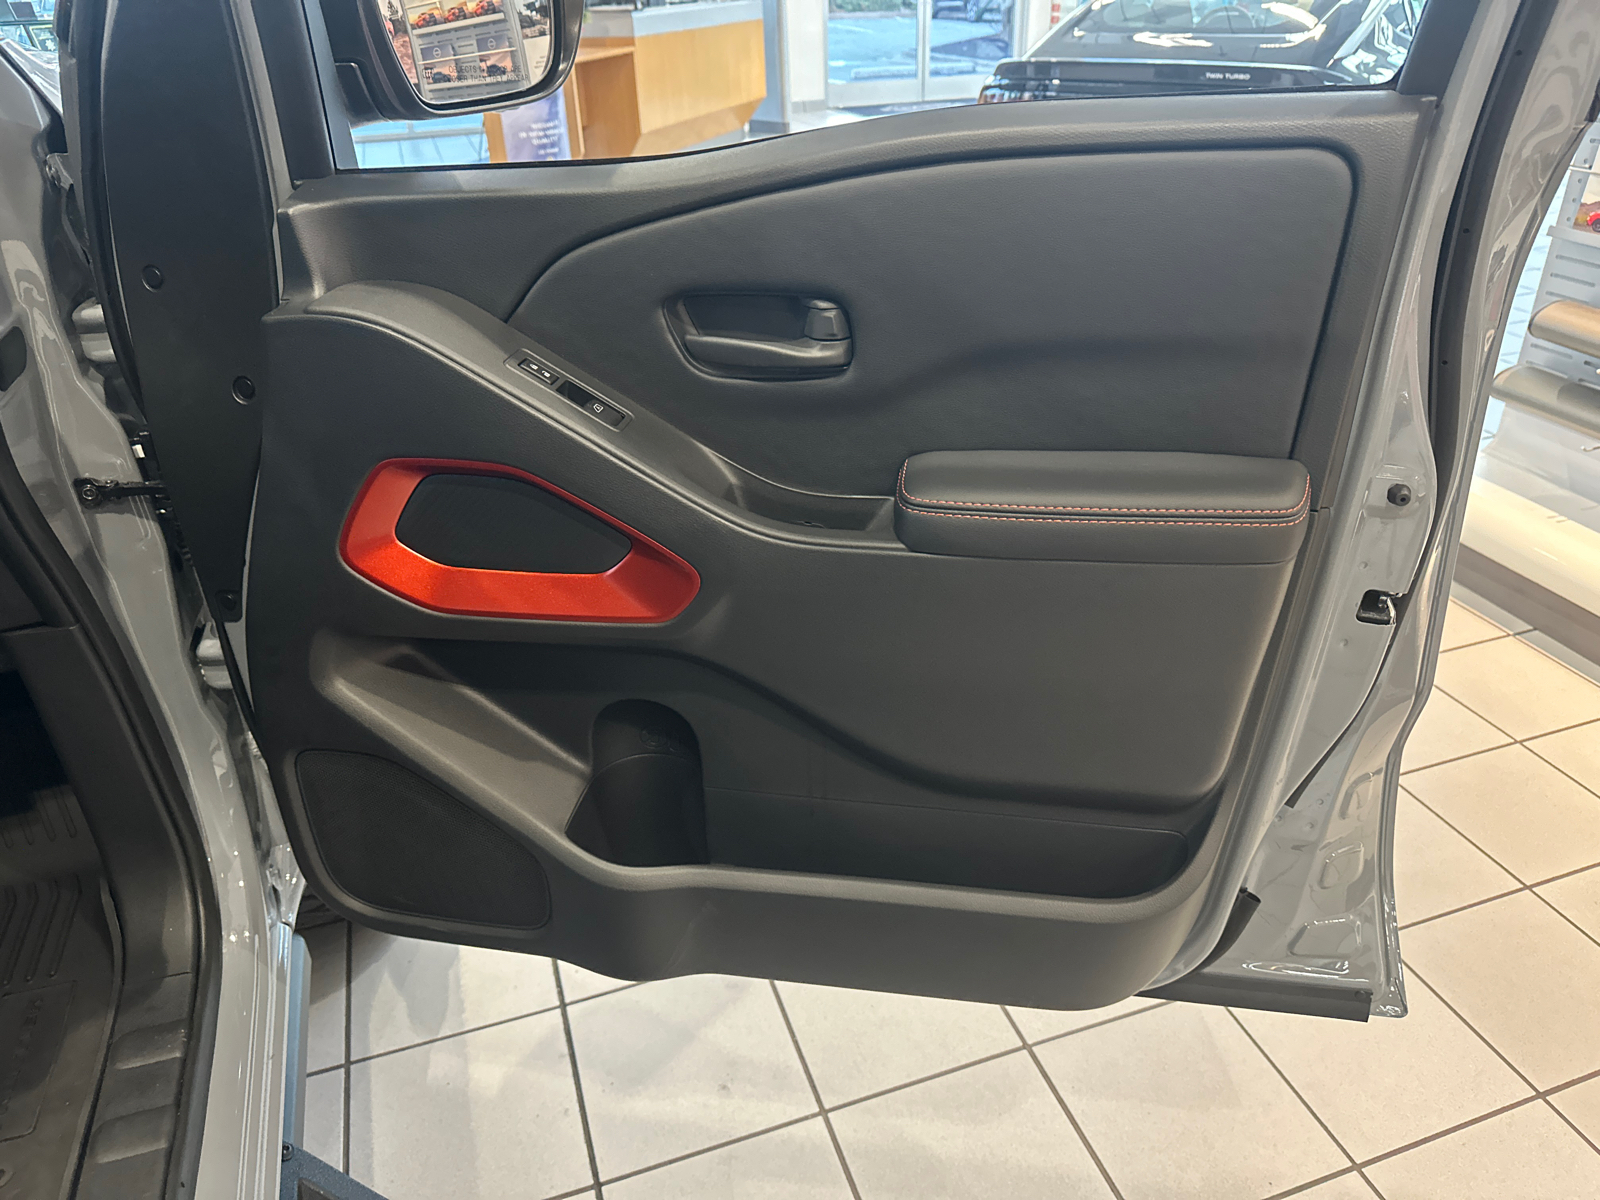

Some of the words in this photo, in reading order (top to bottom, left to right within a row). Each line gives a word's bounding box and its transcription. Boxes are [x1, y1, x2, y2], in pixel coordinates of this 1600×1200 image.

[448, 65, 477, 74] OBJECTS
[506, 73, 529, 82] APPEAR
[1205, 72, 1224, 80] TWIN
[1225, 72, 1251, 81] TURBO
